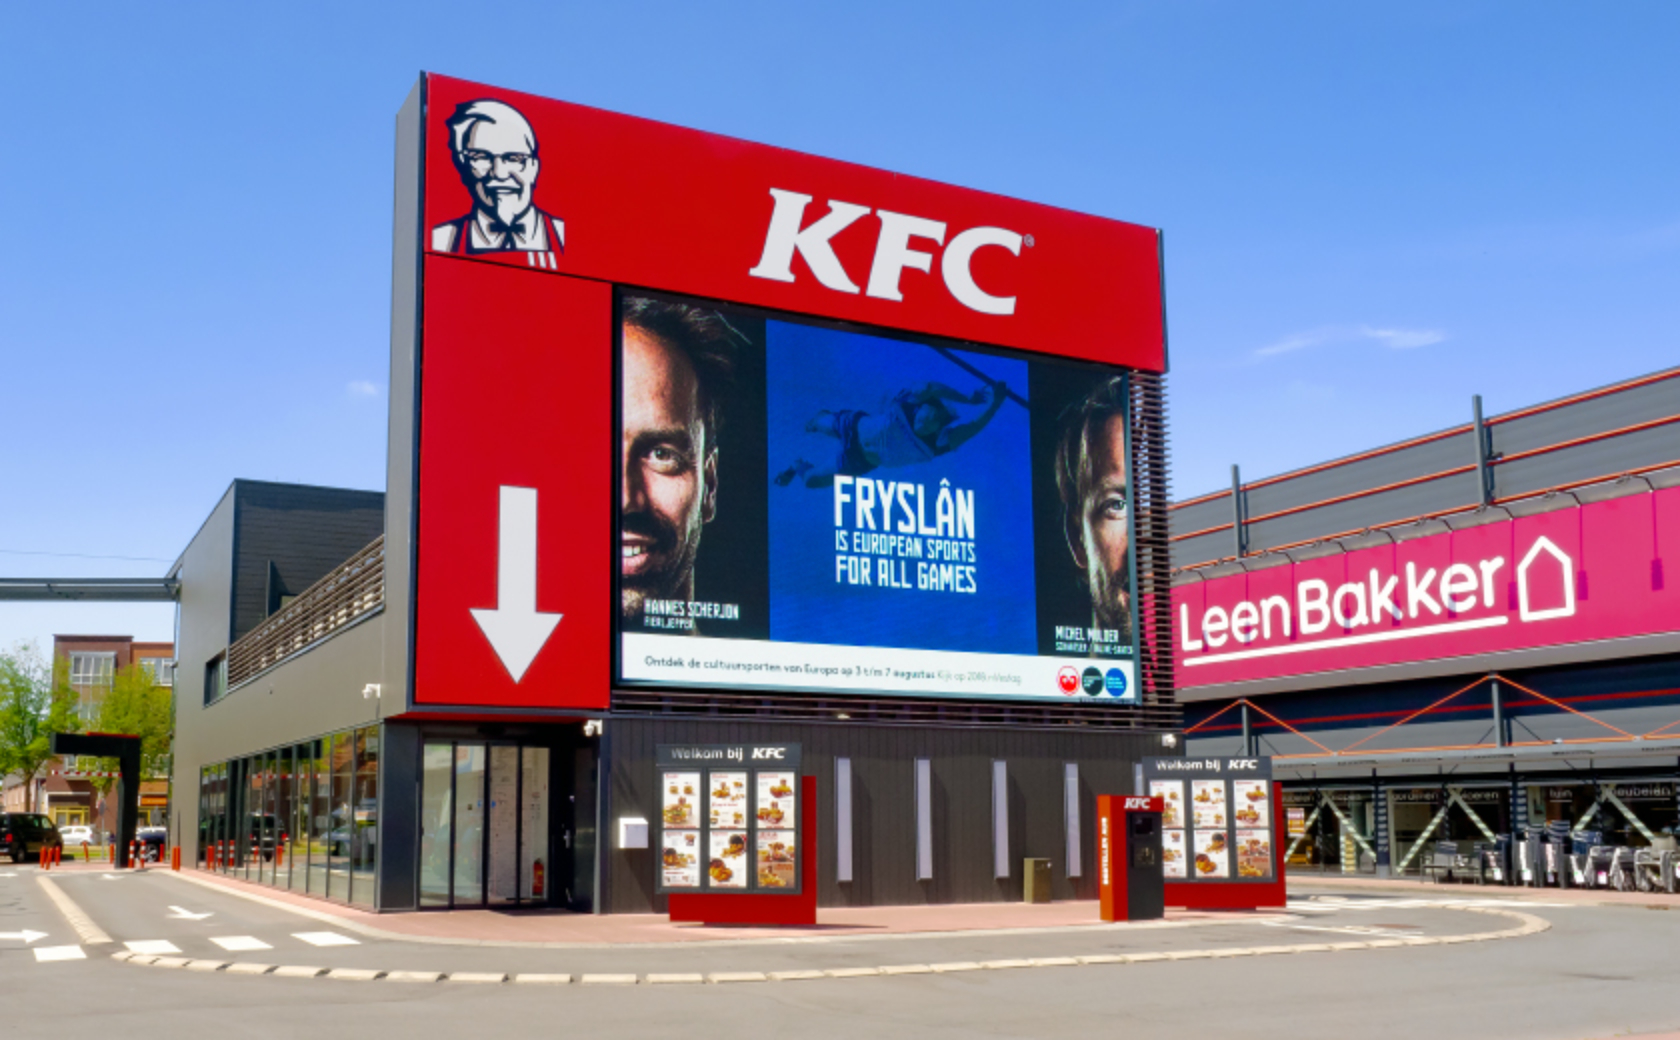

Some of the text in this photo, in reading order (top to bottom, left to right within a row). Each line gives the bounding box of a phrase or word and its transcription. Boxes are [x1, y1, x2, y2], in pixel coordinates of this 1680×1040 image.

[834, 474, 975, 539] FRYSLÂN
[835, 529, 976, 563] IS EUROPEAN SPORTS
[836, 555, 976, 593] FOR ALL GAMES
[644, 599, 740, 619] HANNES SCHERJON
[644, 655, 684, 668] Ontdek
[688, 658, 701, 668] de
[703, 659, 781, 673] cultuursporten
[784, 664, 802, 673] van
[804, 664, 839, 676] Europa
[841, 668, 852, 676] op
[856, 666, 861, 675] 3
[671, 748, 786, 762] Welkom bij KFC
[1156, 759, 1258, 771] Welkom bij KFC
[1123, 798, 1150, 809] KFC
